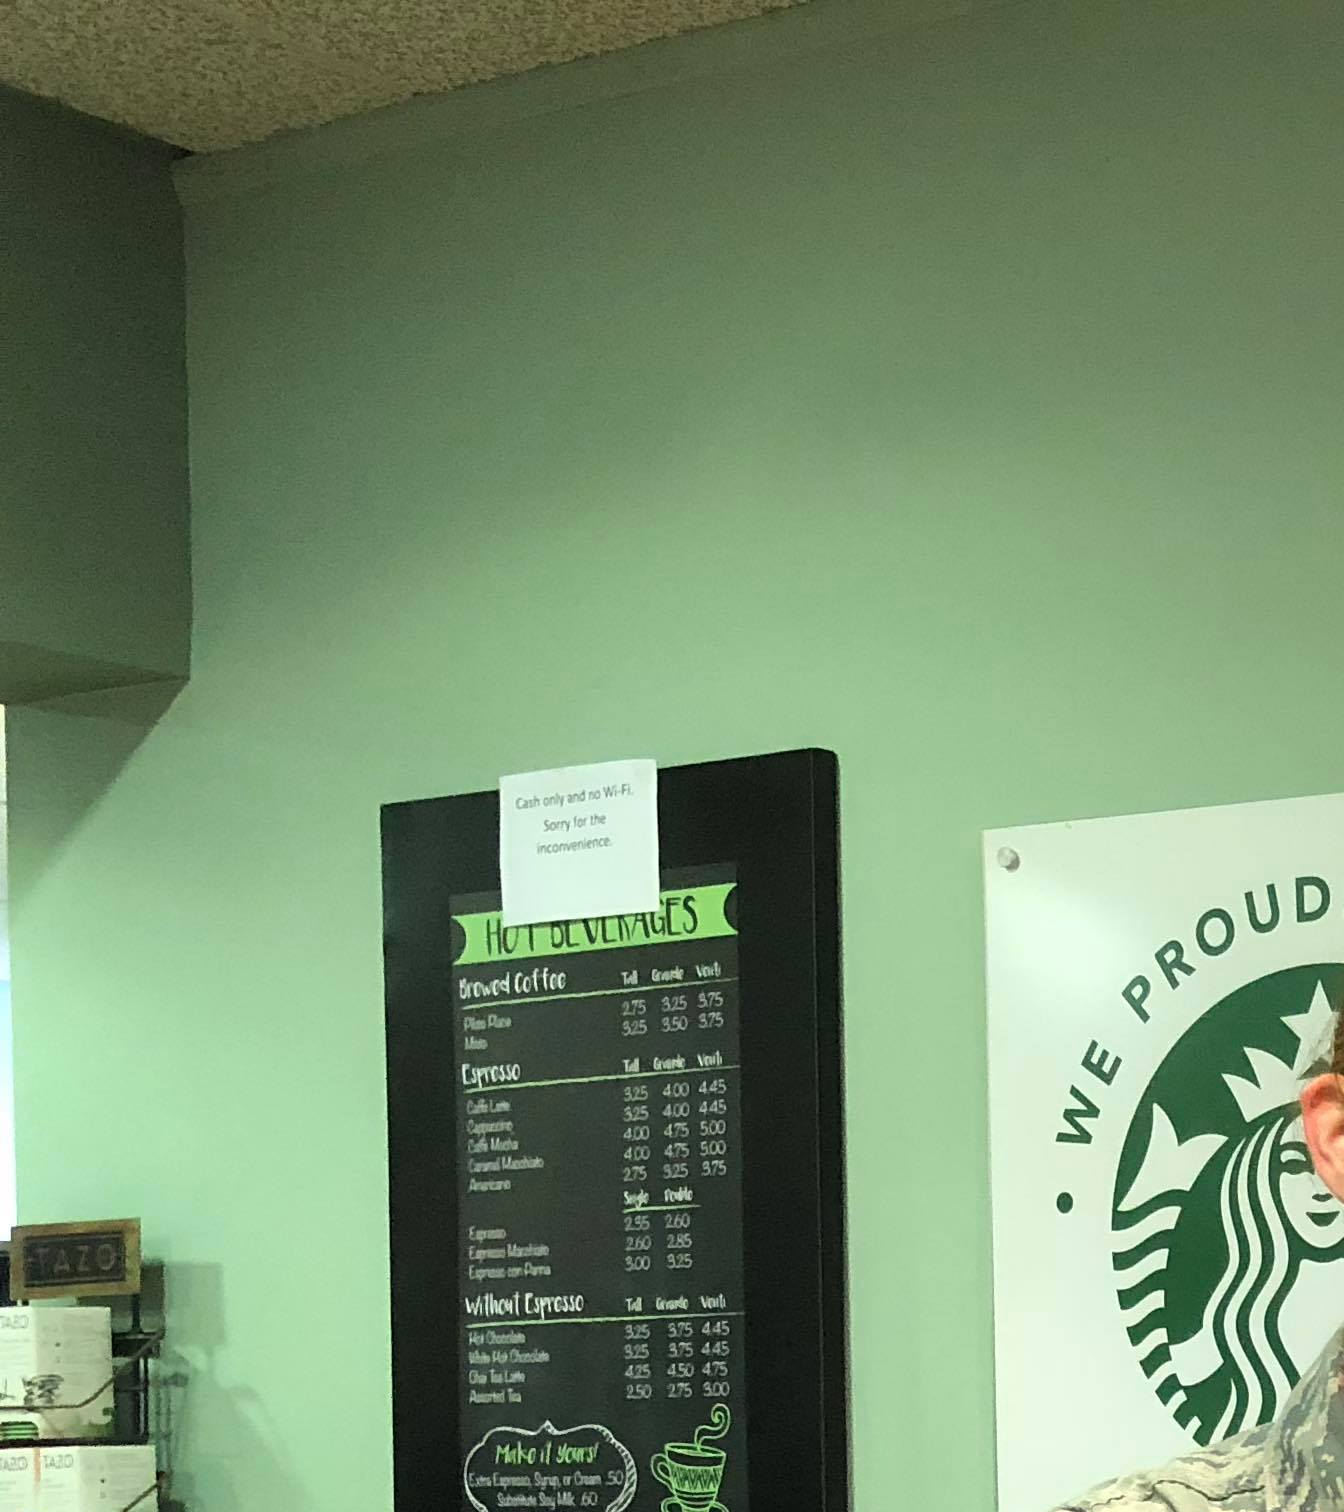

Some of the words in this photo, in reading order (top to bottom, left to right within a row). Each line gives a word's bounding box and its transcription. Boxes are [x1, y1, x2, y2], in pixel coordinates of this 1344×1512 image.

[515, 796, 540, 810] Cash
[543, 794, 565, 808] only
[567, 790, 586, 804] and
[588, 790, 601, 802] no
[543, 819, 570, 834] Sorry
[573, 815, 588, 830] for
[590, 813, 606, 827] the
[537, 836, 613, 855] inconvenience.
[459, 972, 510, 999] Brewed
[514, 968, 567, 993] Coffee
[462, 1063, 520, 1088] Espresso
[1056, 1038, 1122, 1150] WE
[466, 1293, 519, 1316] Without
[525, 1292, 584, 1320] Espresso
[495, 1441, 537, 1464] Make
[540, 1440, 552, 1464] it
[556, 1441, 599, 1464] yours!
